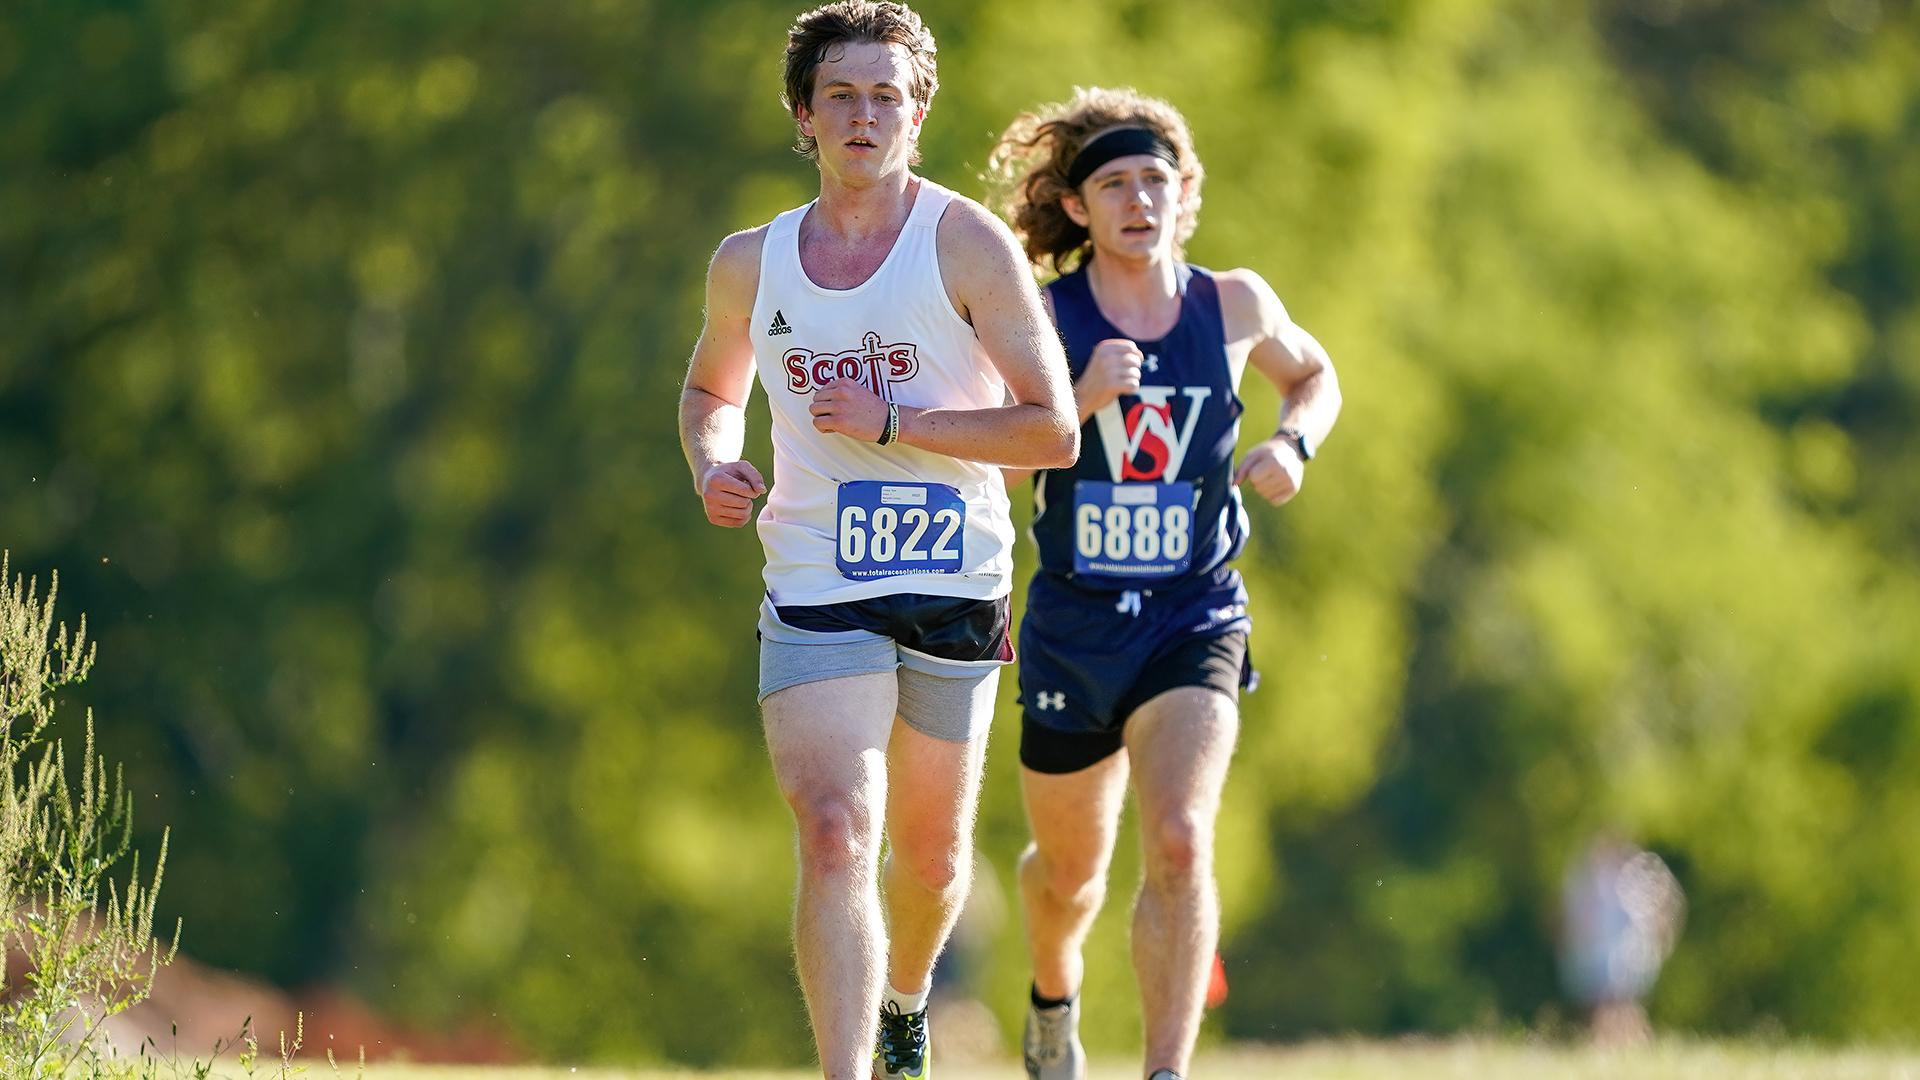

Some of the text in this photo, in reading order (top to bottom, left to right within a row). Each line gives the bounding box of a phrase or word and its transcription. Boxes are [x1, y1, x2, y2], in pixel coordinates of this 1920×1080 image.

[767, 325, 793, 337] adidas
[783, 332, 919, 398] SCOTS
[840, 506, 961, 563] 6822
[1076, 503, 1190, 561] 6888
[852, 567, 945, 577] www.totalracesolutions.com
